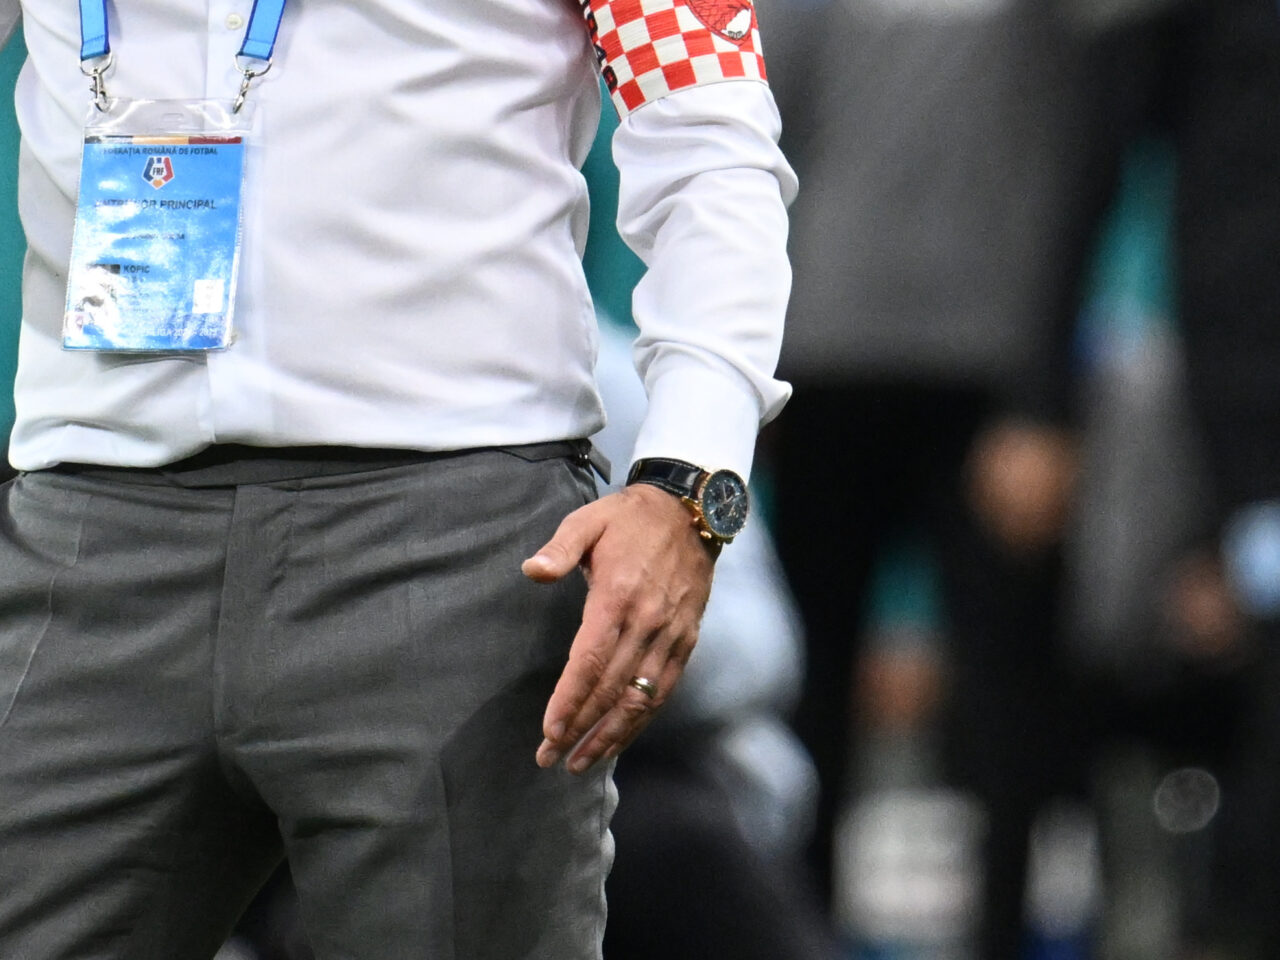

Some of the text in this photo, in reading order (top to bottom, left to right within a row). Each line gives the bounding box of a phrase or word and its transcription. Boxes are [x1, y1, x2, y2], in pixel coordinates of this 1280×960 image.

[178, 147, 189, 155] DE
[190, 147, 218, 156] FOTBAL
[152, 167, 164, 176] FRF
[160, 199, 217, 210] PRINCIPAL
[123, 265, 151, 274] KOPIC
